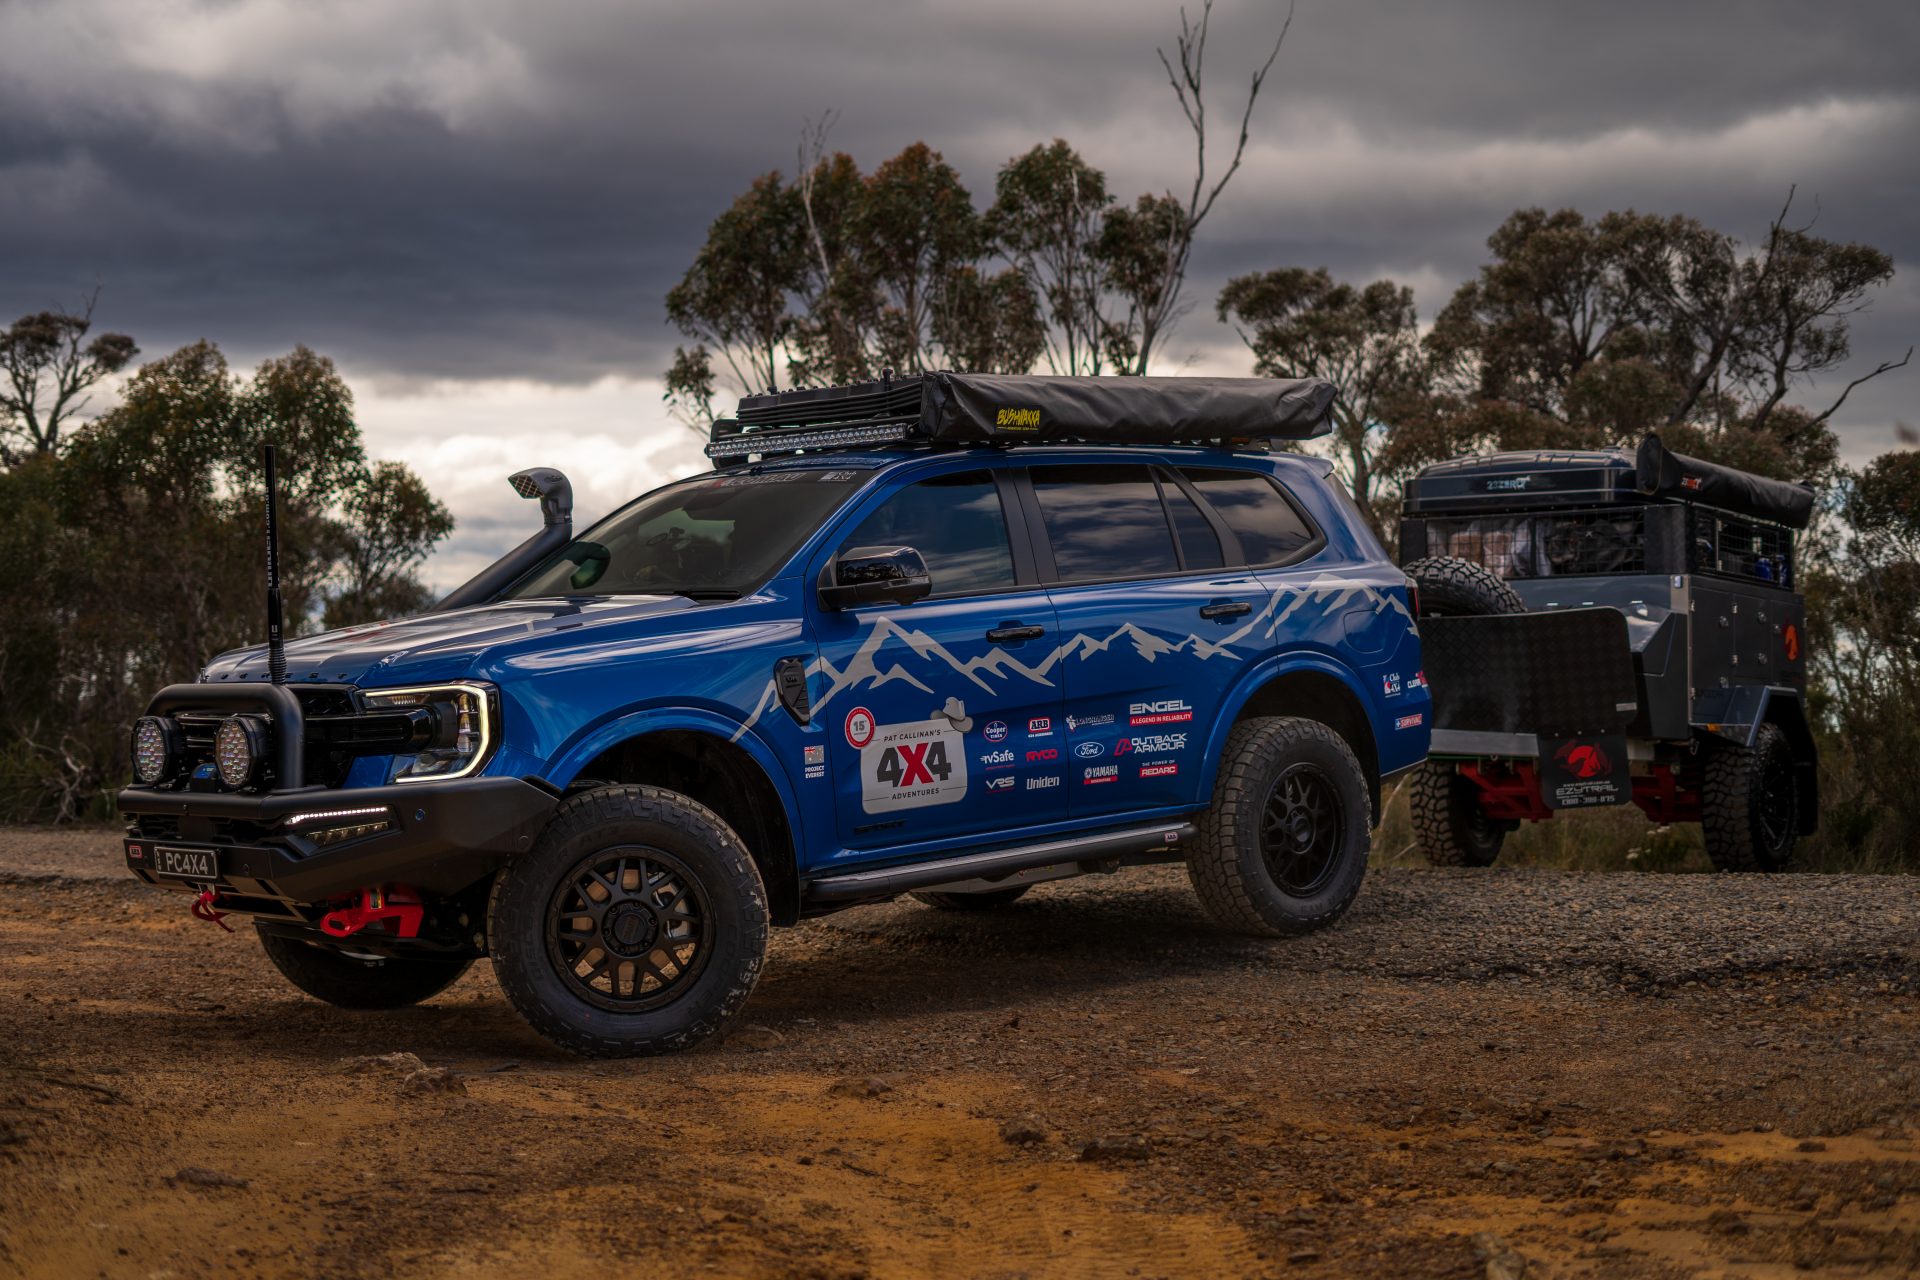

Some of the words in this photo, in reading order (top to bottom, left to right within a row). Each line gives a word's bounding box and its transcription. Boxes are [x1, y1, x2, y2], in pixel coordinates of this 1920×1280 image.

[1130, 700, 1192, 714] ENGEL
[1031, 720, 1049, 730] ARB
[1136, 716, 1156, 724] LEGEND
[1162, 714, 1191, 722] RELIABILITY
[883, 734, 898, 742] PAT
[899, 729, 941, 740] CALLINAN'S
[986, 727, 1006, 735] Cooper
[1131, 733, 1188, 745] OUTBACK
[1081, 742, 1099, 755] Ford
[1134, 741, 1185, 754] ARMOUR
[1026, 749, 1058, 762] RYCO
[805, 765, 824, 773] PROJECT
[876, 741, 952, 787] 4X4
[805, 771, 824, 779] EVEREST
[1092, 765, 1118, 778] YAMAHA
[1142, 766, 1176, 776] REDARC
[1026, 776, 1060, 790] Uniden
[891, 788, 940, 800] ADVENTURES
[165, 852, 208, 875] PC4X4
